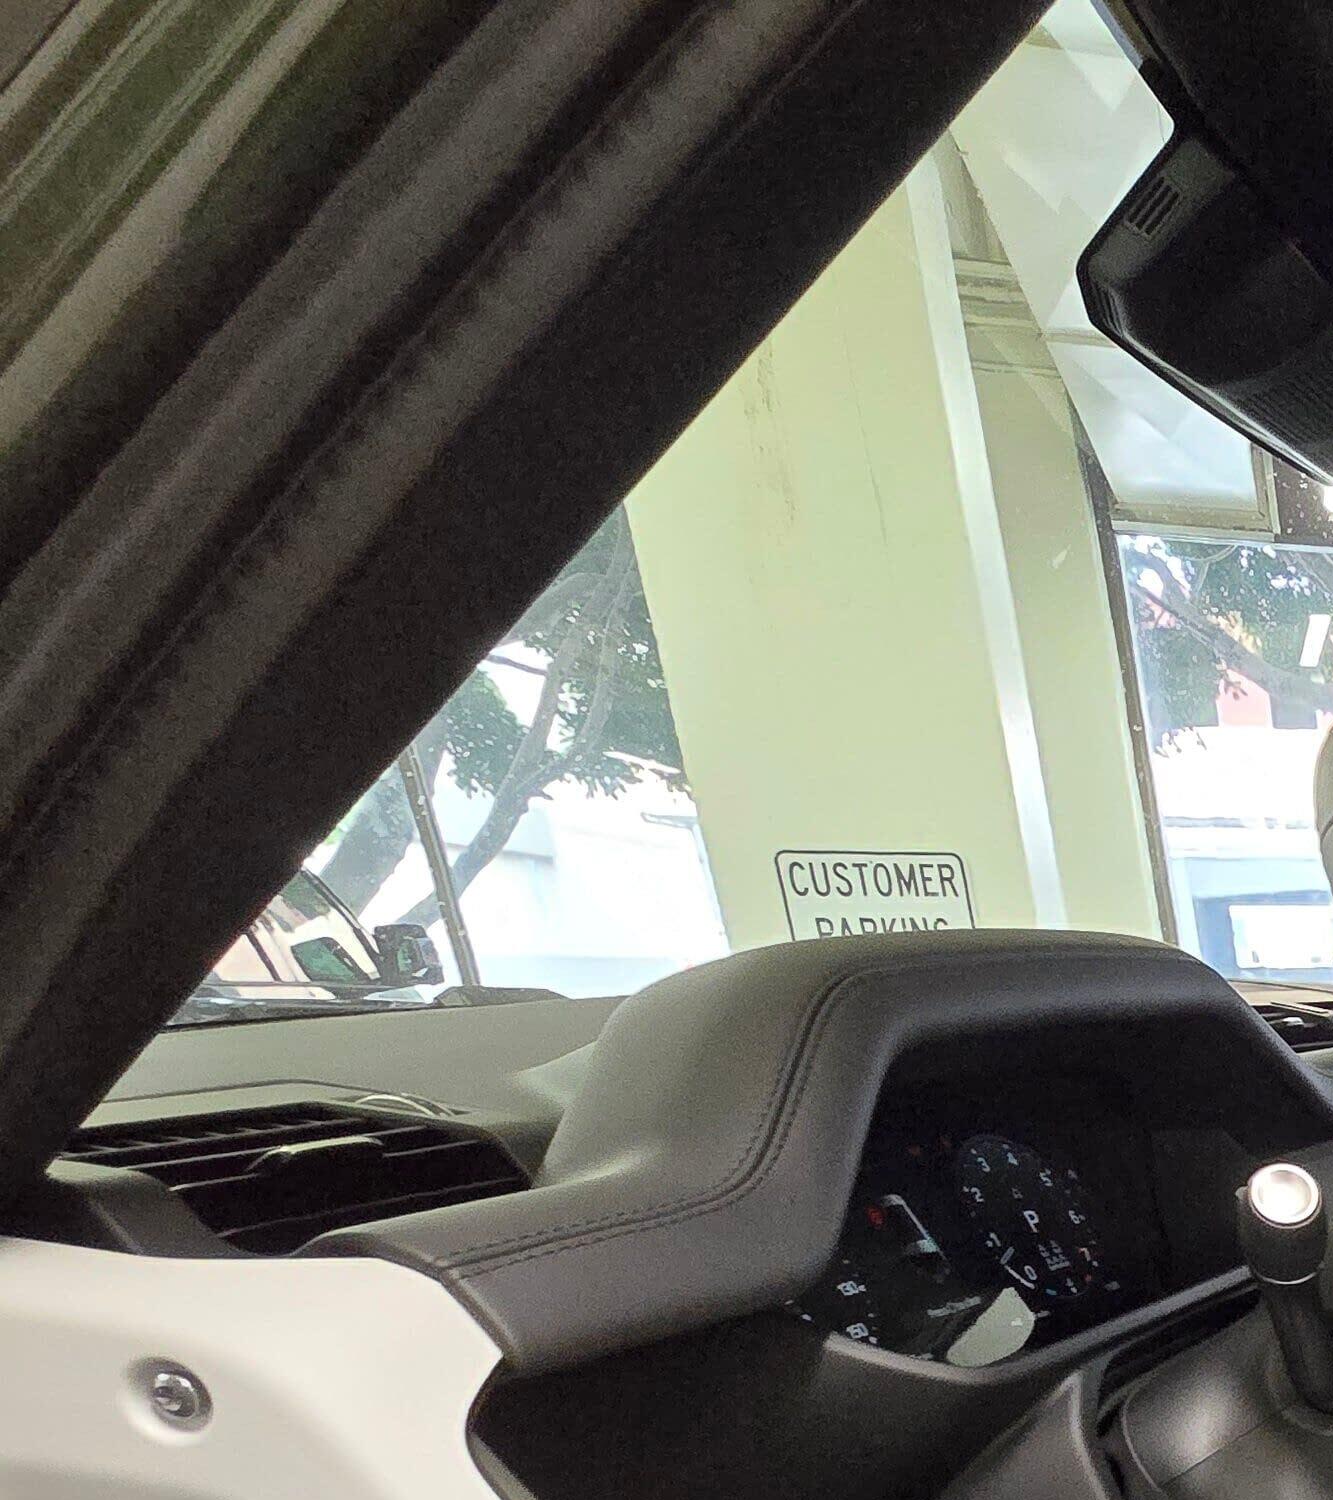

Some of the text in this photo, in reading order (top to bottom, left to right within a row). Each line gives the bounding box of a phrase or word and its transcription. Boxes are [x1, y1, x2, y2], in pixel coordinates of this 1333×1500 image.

[789, 861, 959, 897] CUSTOMER
[976, 1156, 991, 1173] 3
[970, 1186, 985, 1203] 2
[1023, 1209, 1040, 1233] P
